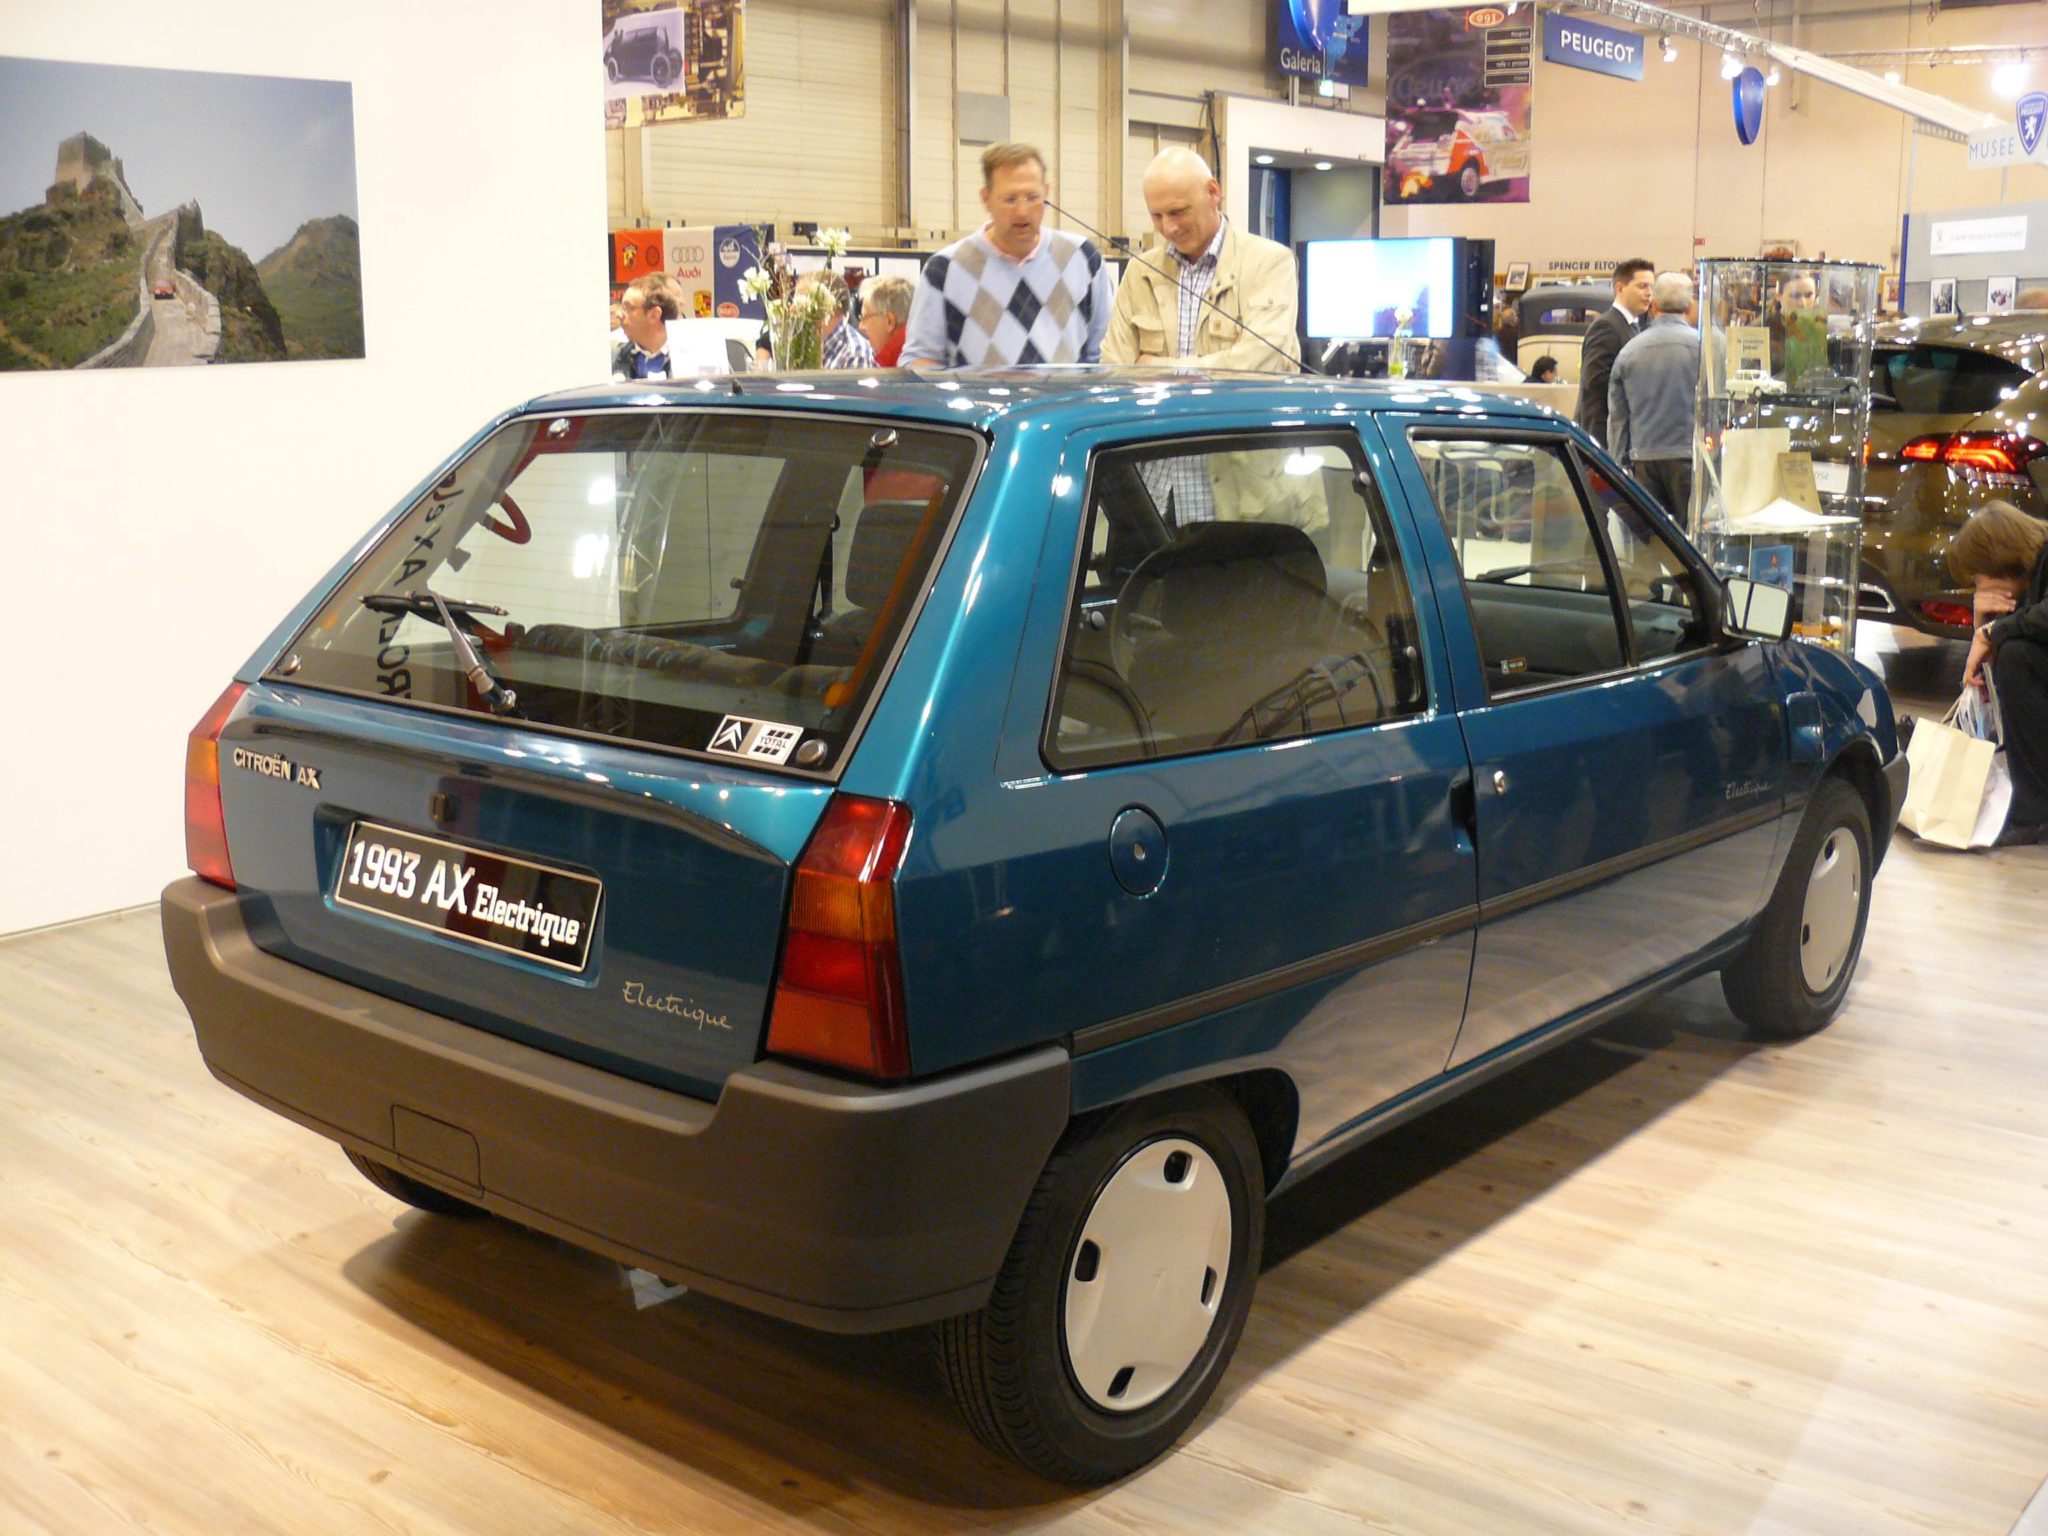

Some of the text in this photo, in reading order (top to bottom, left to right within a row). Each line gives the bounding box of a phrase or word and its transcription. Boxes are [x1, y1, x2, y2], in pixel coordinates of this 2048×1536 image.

[1560, 29, 1634, 63] PEUGEOT
[1280, 47, 1321, 75] Galeria
[1968, 137, 2015, 160] MUSEE
[677, 267, 702, 278] Audi
[1548, 261, 1590, 270] SPENCER
[760, 736, 788, 749] TOTAL
[233, 747, 321, 790] CITROËN AX
[349, 840, 580, 947] 1993 AX Electrique
[622, 981, 733, 1032] Electrique
